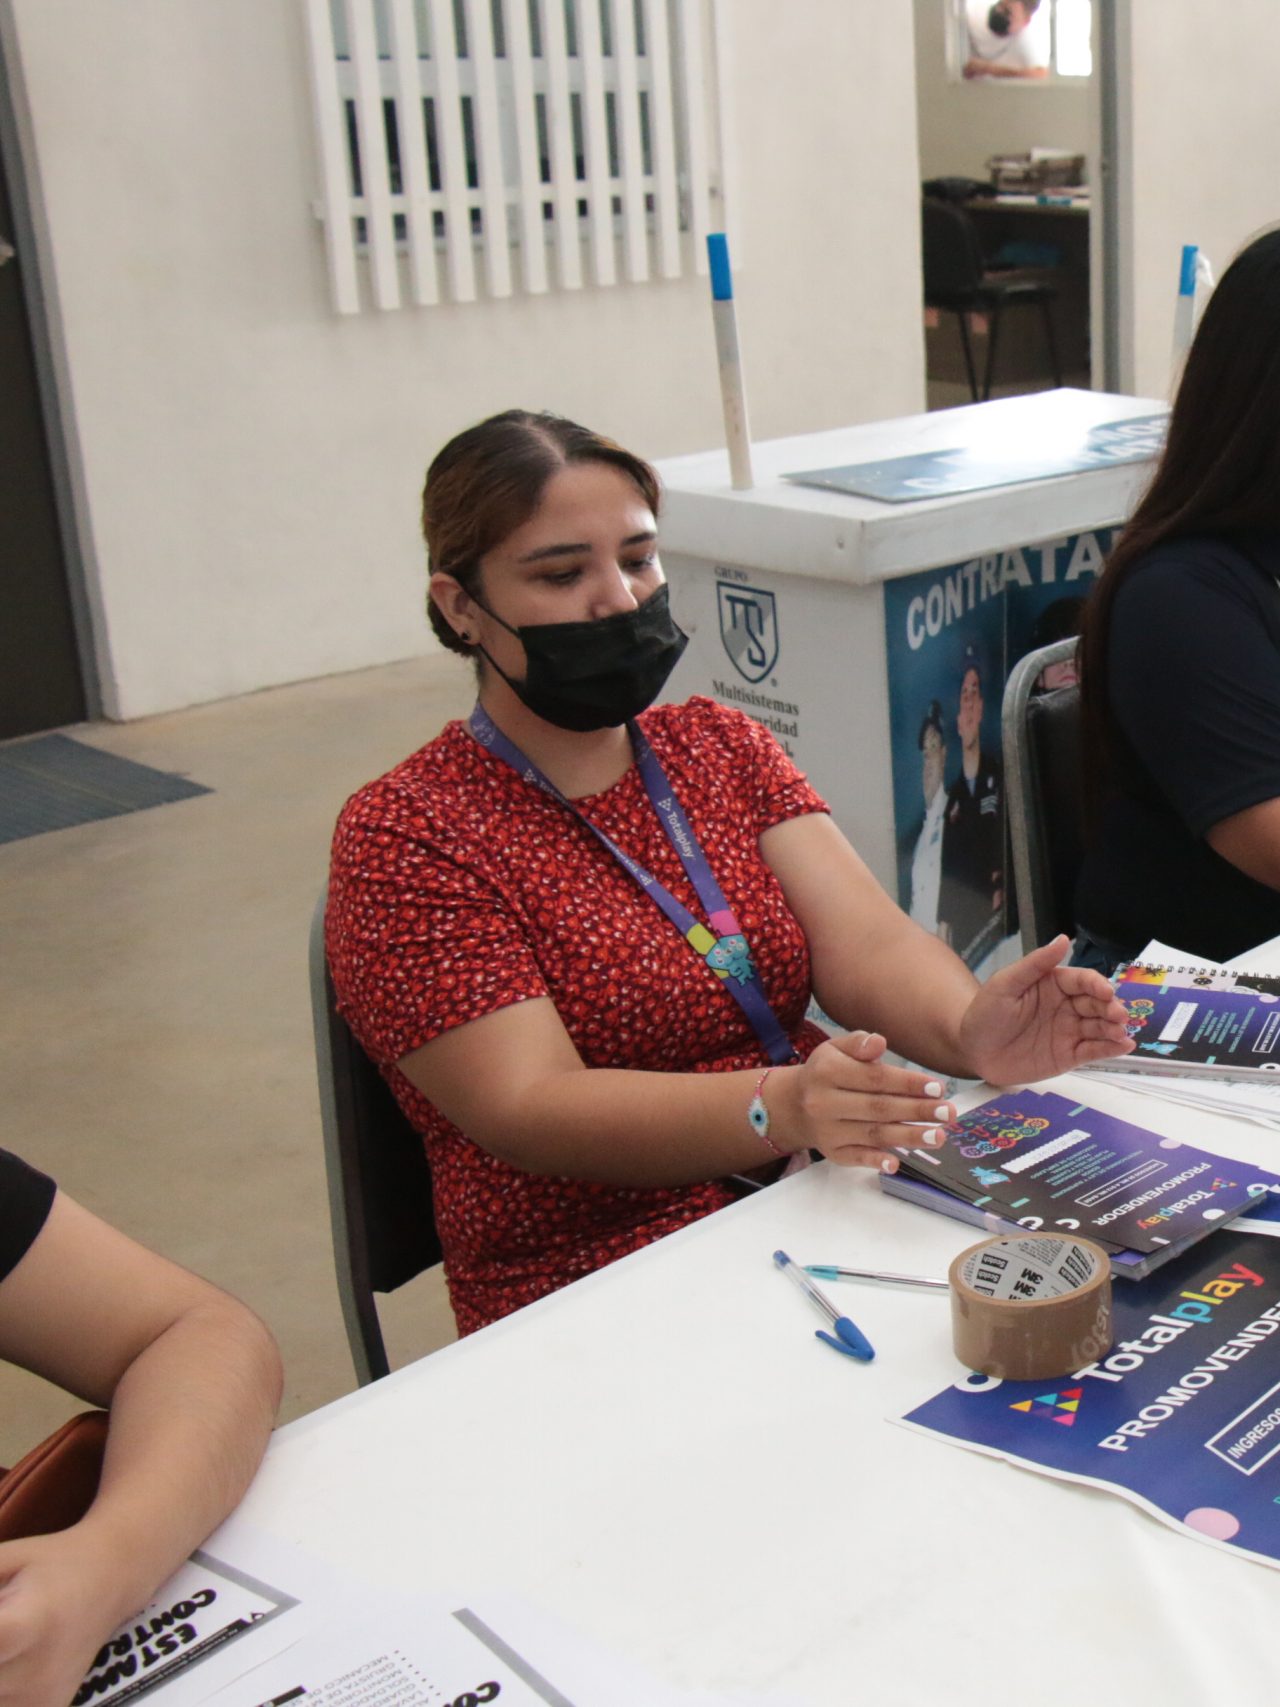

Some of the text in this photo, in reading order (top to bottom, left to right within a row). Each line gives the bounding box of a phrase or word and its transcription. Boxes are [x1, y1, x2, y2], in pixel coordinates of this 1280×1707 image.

[712, 679, 799, 716] Multisistemas
[667, 811, 695, 859] Totalplay
[1096, 1162, 1212, 1227] PROMOVENDEDOR
[1137, 1190, 1215, 1230] Totalplay
[978, 1270, 1001, 1283] Scotch
[983, 1256, 1007, 1269] Scotch
[1021, 1268, 1044, 1285] 3M
[1013, 1280, 1036, 1297] 3M
[1071, 1262, 1265, 1383] Totalplay
[324, 1655, 389, 1690] MECANICO
[443, 1681, 501, 1707] CO
